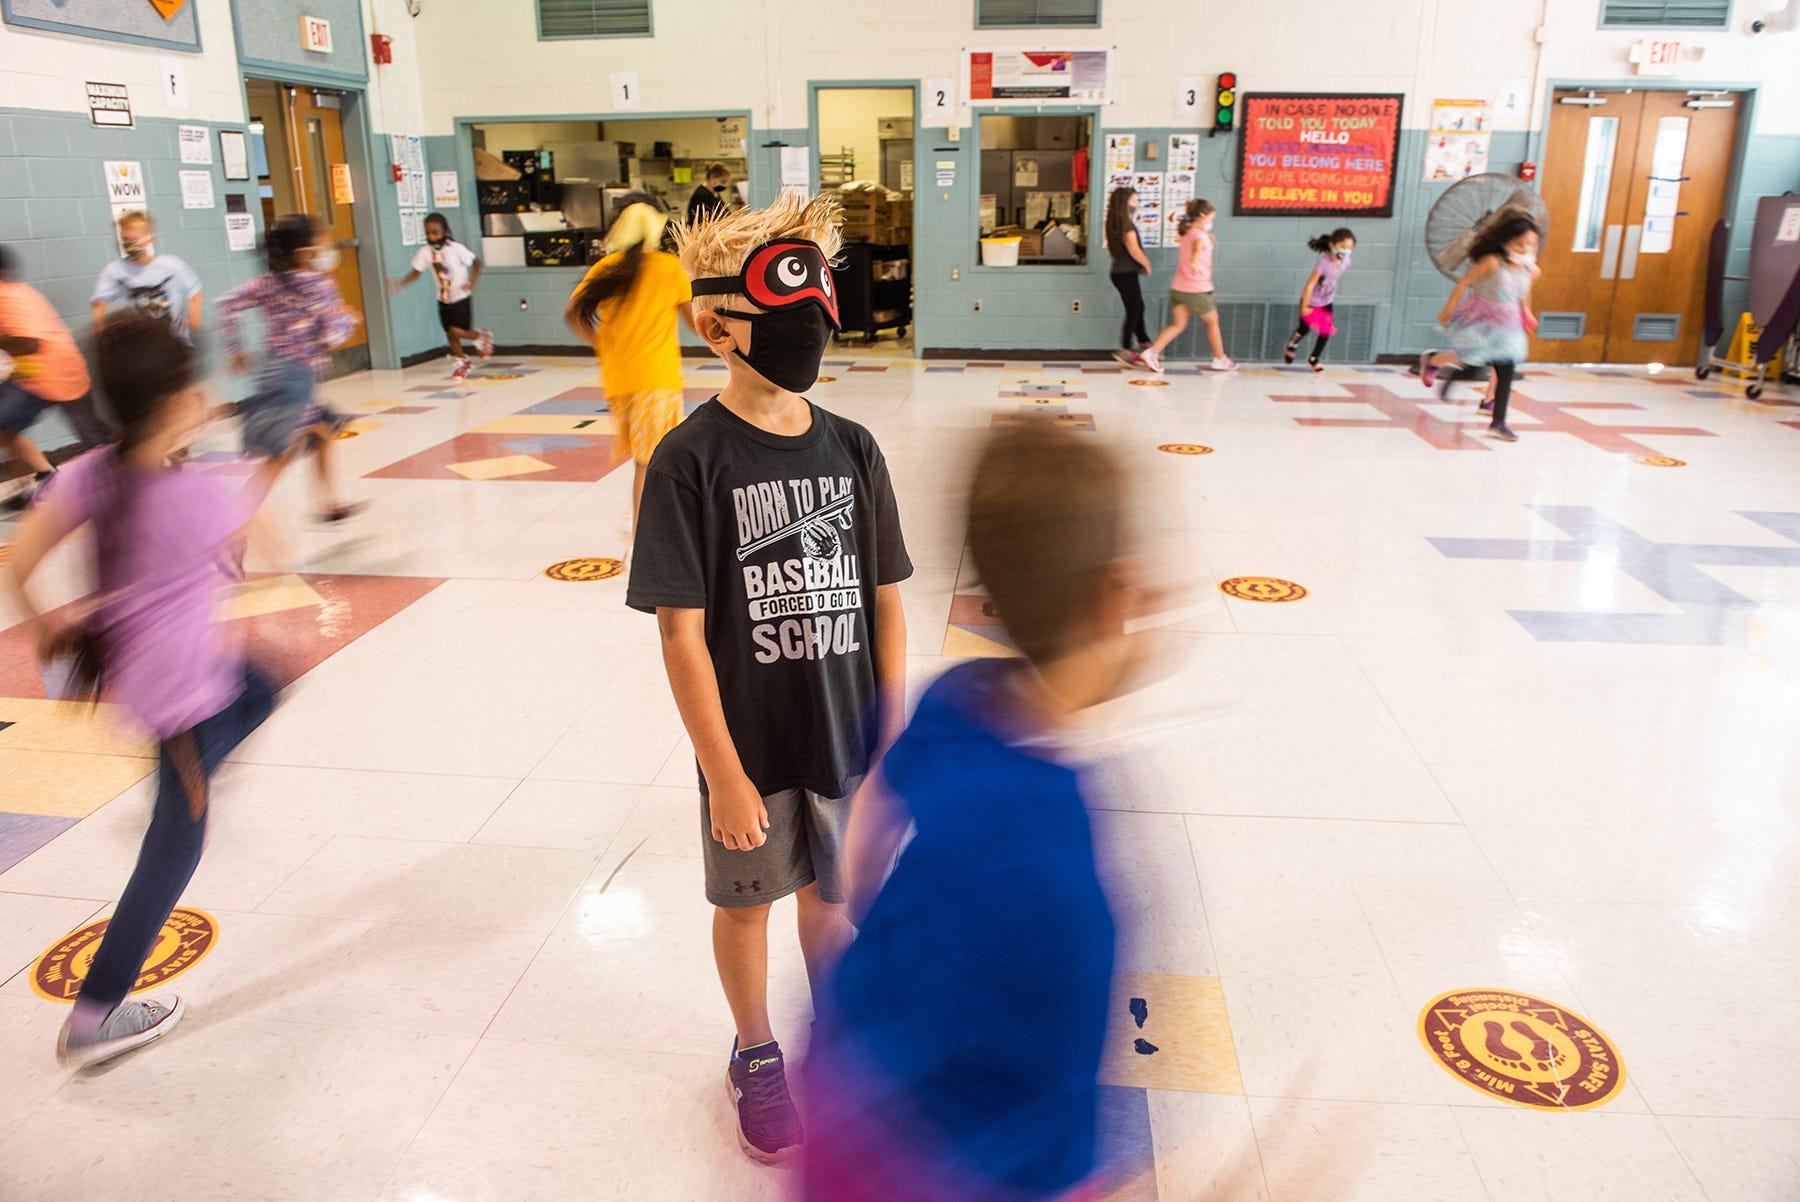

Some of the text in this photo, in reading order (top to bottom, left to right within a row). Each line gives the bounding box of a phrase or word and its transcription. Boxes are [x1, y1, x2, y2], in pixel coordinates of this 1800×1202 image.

[310, 21, 328, 47] EXIT
[1649, 41, 1680, 64] EXIT
[169, 73, 176, 95] F
[622, 84, 629, 100] 1
[89, 96, 130, 111] CAPACITY
[936, 90, 945, 107] 2
[1186, 89, 1196, 106] 3
[1506, 93, 1516, 110] 4
[1265, 104, 1280, 115] IN
[1285, 104, 1326, 116] CASE
[1258, 117, 1294, 130] TOLD
[1300, 117, 1327, 130] YOU
[1300, 131, 1350, 145] HELLO
[1260, 141, 1300, 155] GOOD
[1249, 154, 1386, 172] YOU BELONG HERE
[111, 183, 141, 196] WOW
[1249, 187, 1374, 205] I BELIEVE IN YOU
[732, 476, 853, 547] BORN TO PLAY
[742, 554, 860, 599] BASEBALL
[760, 595, 814, 617] FORCED
[830, 592, 843, 608] GO
[846, 591, 857, 606] TO
[44, 931, 97, 983] Min. 6 Feet
[160, 949, 198, 975] STAY
[1448, 994, 1529, 1007] Distancing
[1469, 1003, 1520, 1013] Social
[1434, 1030, 1516, 1094] Min. 6 Feet
[1574, 1029, 1610, 1094] STAY SAFE
